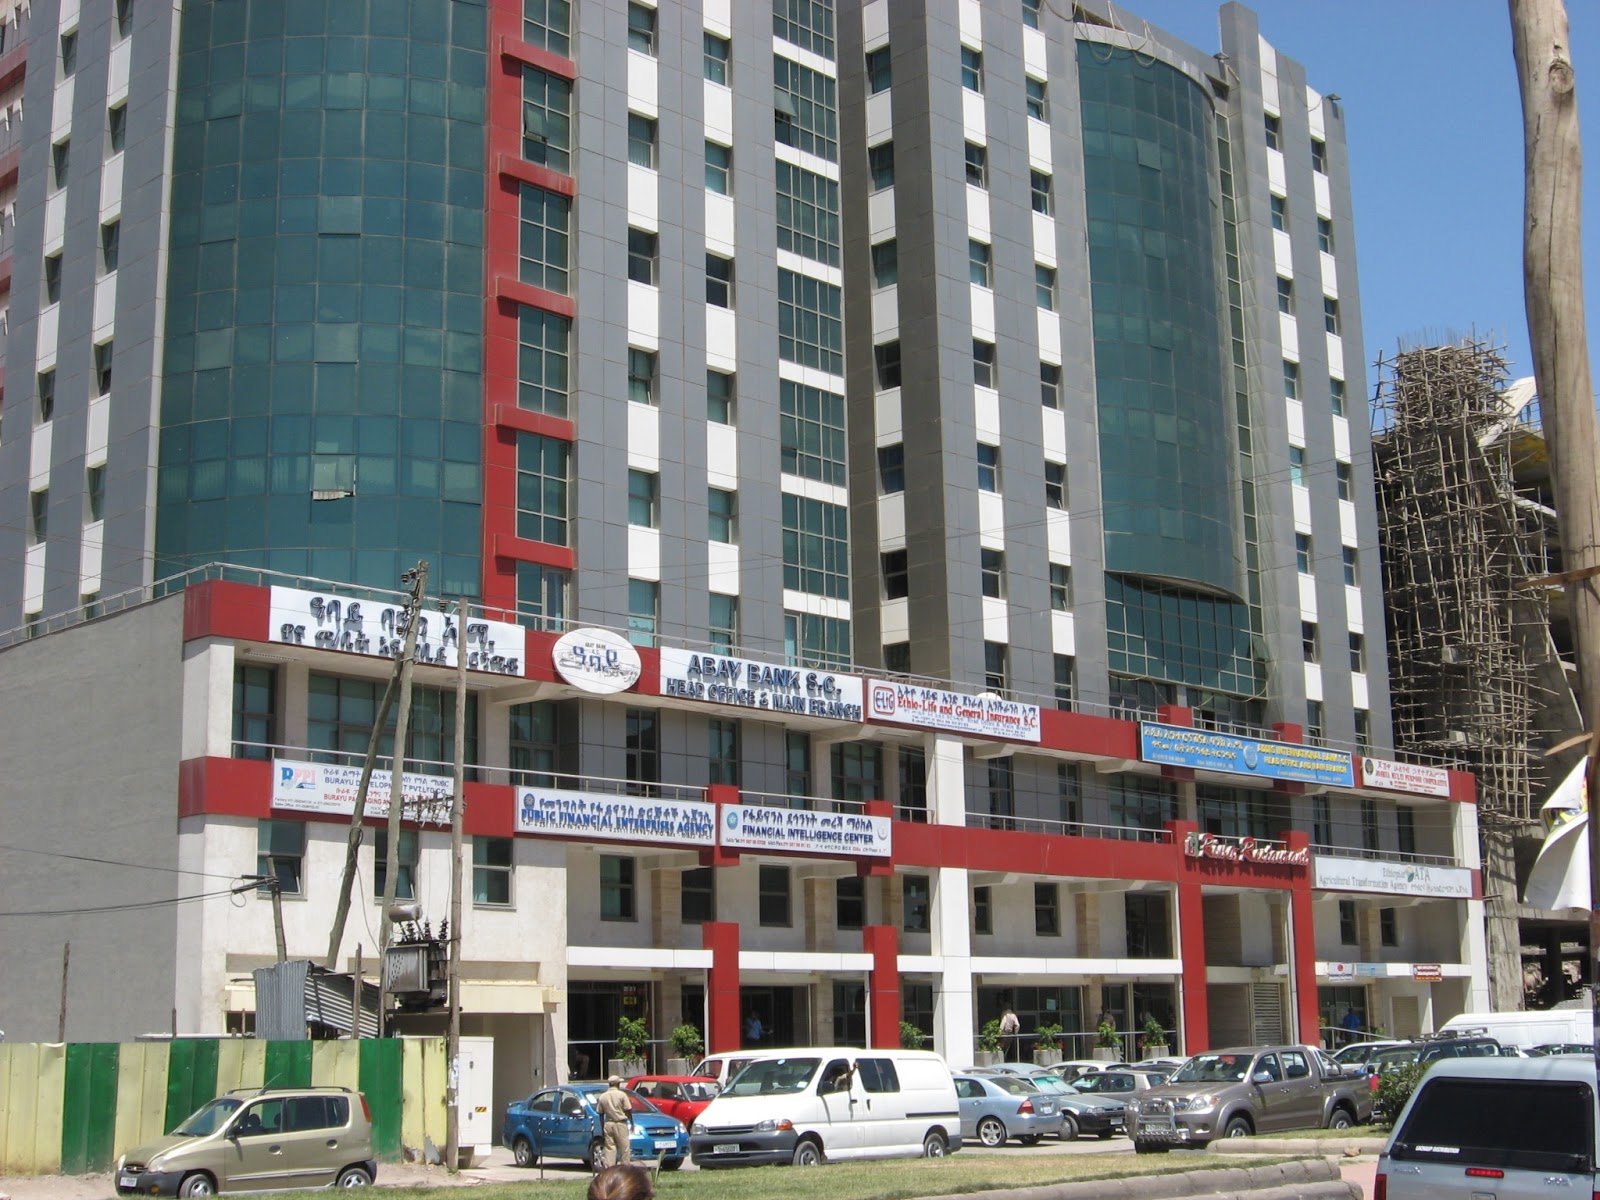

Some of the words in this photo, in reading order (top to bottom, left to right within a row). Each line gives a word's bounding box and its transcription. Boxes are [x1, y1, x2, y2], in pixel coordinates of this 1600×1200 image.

[687, 655, 741, 681] ABAY
[747, 664, 800, 689] BANK
[806, 673, 842, 694] S.C.
[666, 678, 704, 698] HEAD
[708, 684, 755, 706] OFFICE
[760, 691, 769, 706] &
[772, 693, 806, 713] MAIN
[809, 699, 861, 720] BRANCH
[898, 696, 936, 712] Ethio-Life
[940, 704, 952, 716] and
[956, 705, 984, 720] General
[987, 710, 1020, 725] Insurance
[325, 777, 353, 786] BURAYU
[521, 809, 556, 822] PUBLIC
[559, 812, 612, 827] FINANCIAL
[616, 817, 674, 832] ENTERPRISES
[677, 822, 713, 838] AGENCY
[742, 825, 785, 838] FINANCIAL
[788, 829, 842, 842] INTELLIGENCE
[844, 833, 873, 844] CENTER
[1414, 866, 1430, 882] ATA
